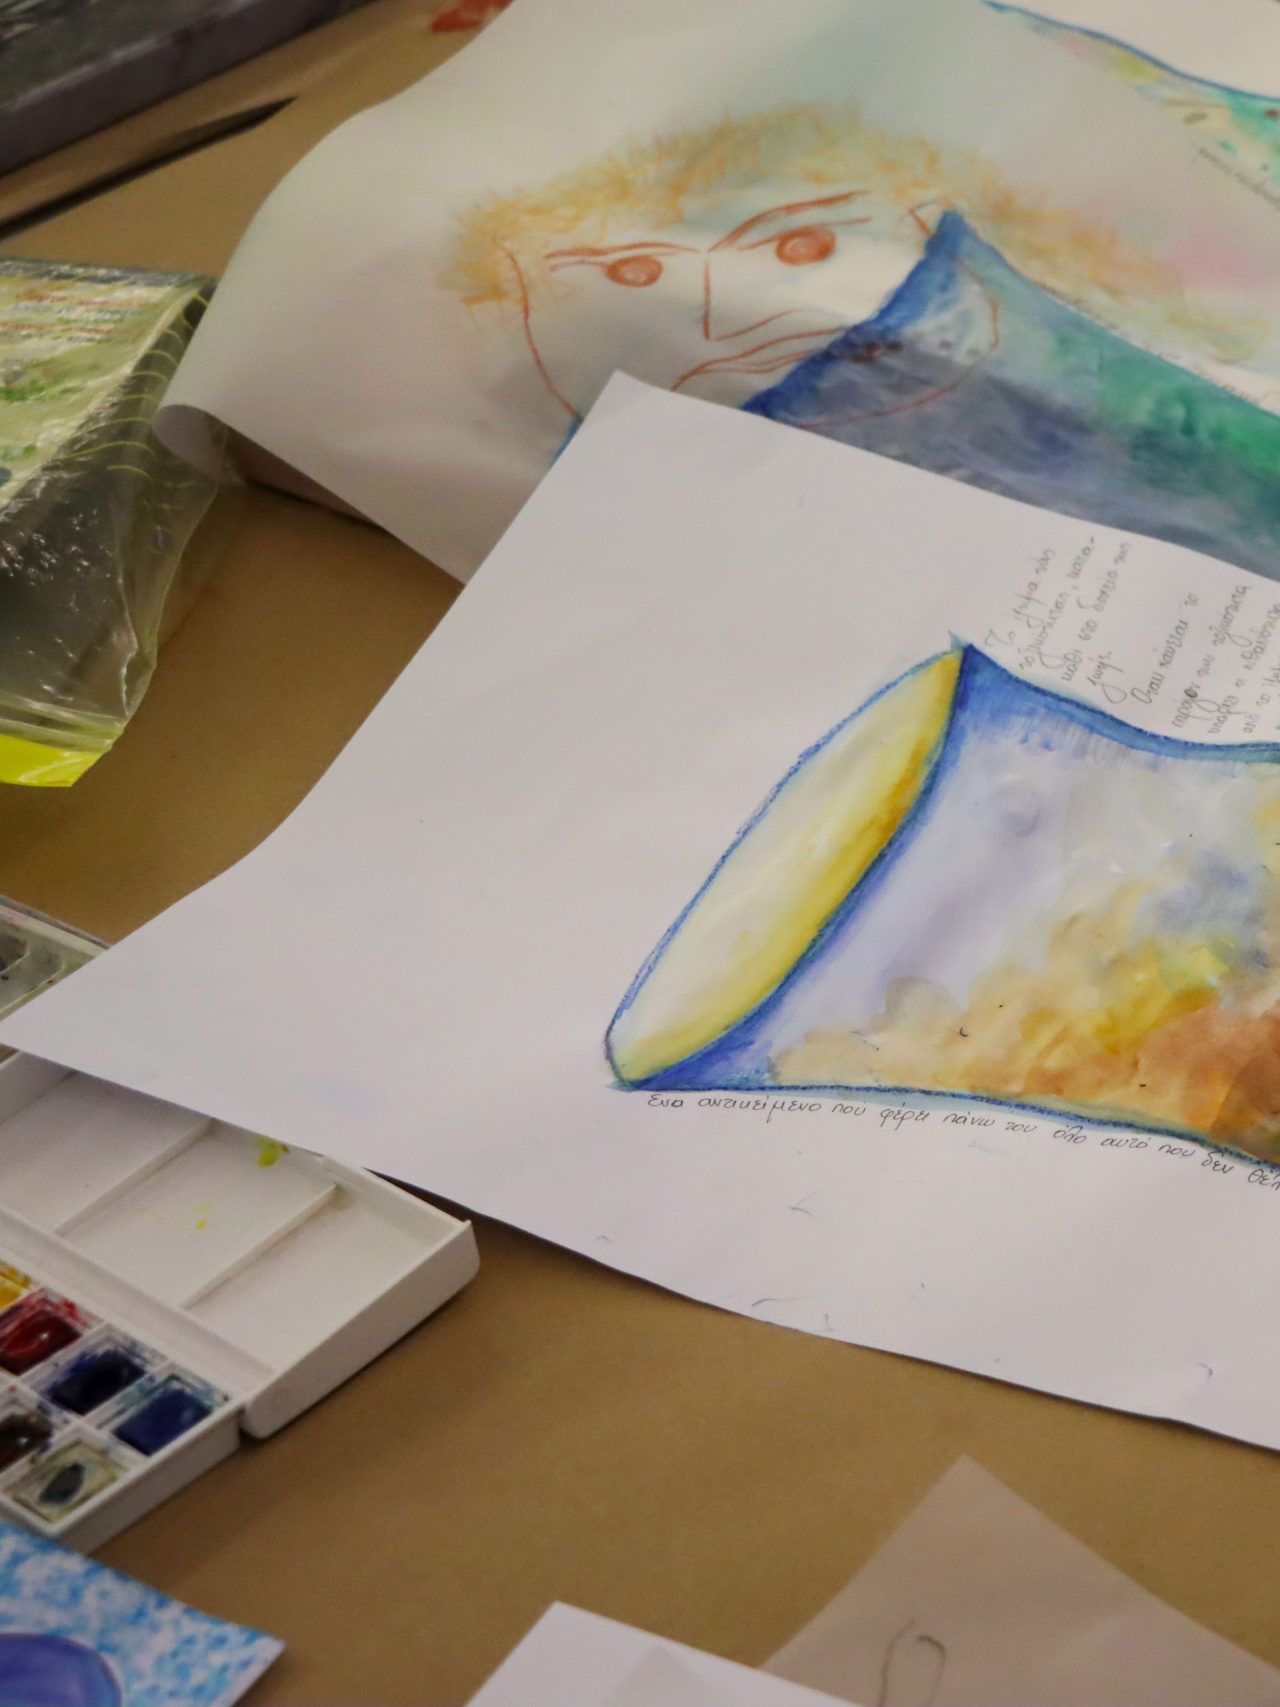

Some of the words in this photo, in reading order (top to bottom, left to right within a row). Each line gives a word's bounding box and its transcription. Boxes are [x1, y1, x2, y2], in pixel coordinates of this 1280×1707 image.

[698, 1095, 822, 1124] αντικείμενο
[880, 1102, 930, 1131] φέρει
[943, 1111, 995, 1128] πάνω
[1005, 1121, 1038, 1133] του
[1053, 1125, 1087, 1144] όλο
[1100, 1136, 1149, 1151] αυτό
[1158, 1144, 1196, 1158] που
[1200, 1151, 1234, 1174] δεν
